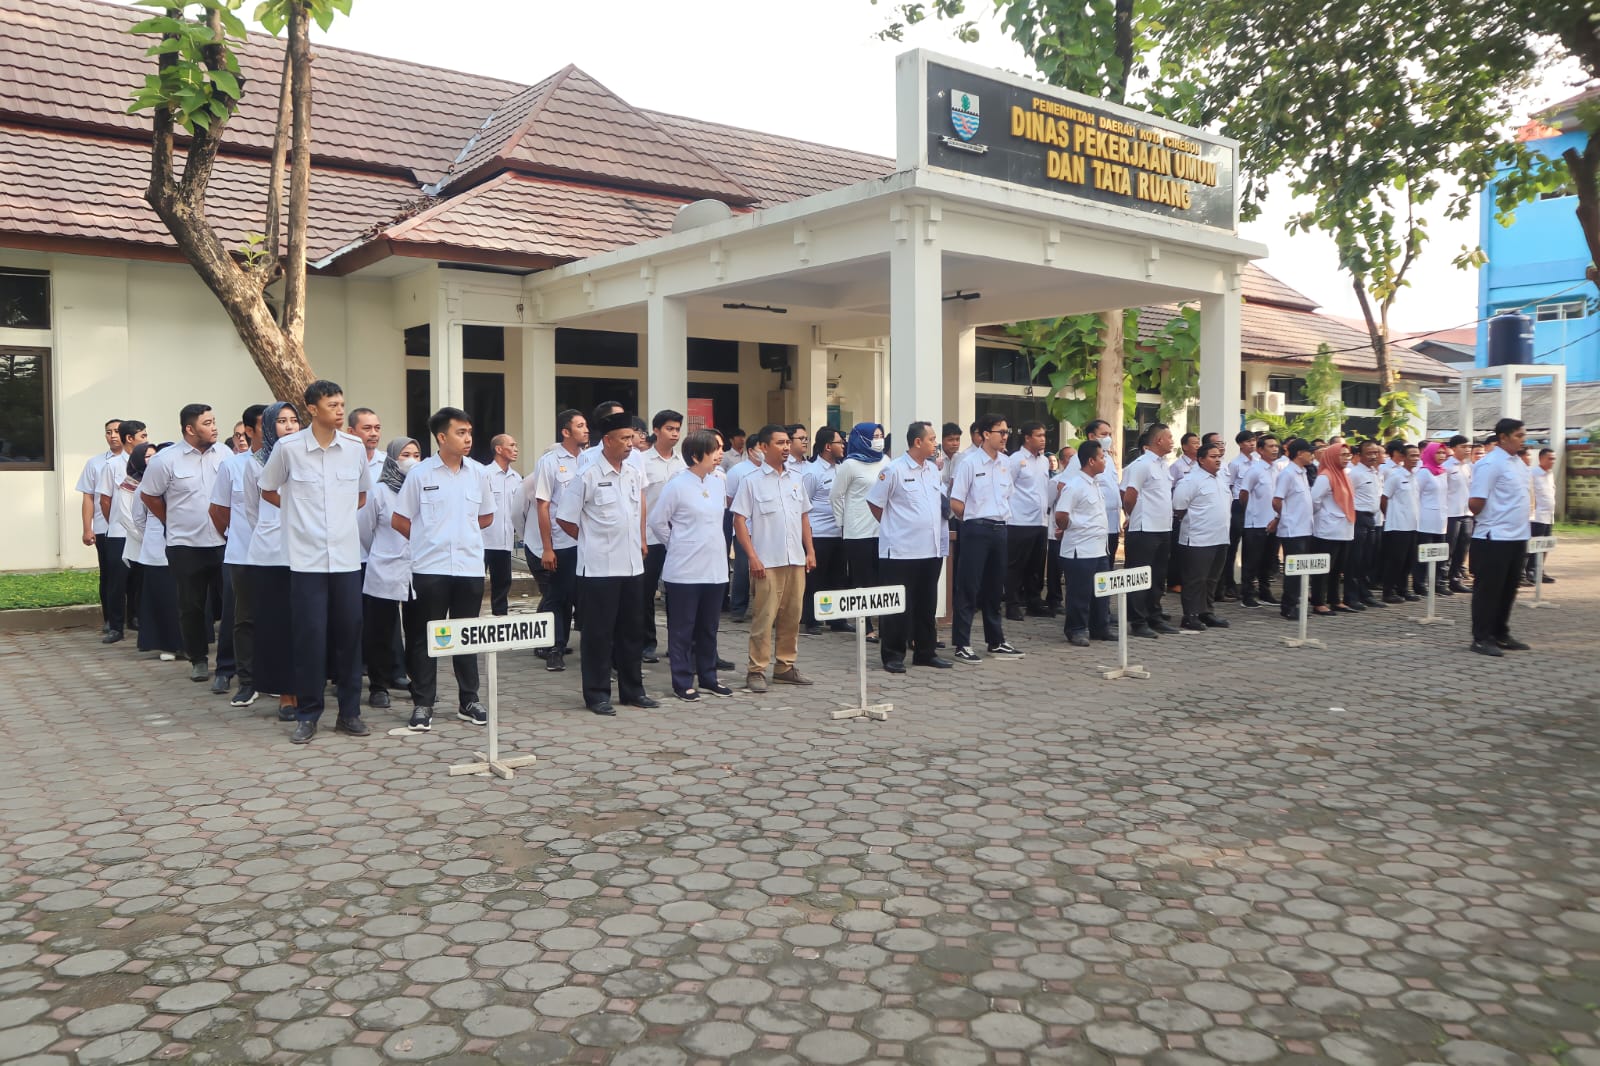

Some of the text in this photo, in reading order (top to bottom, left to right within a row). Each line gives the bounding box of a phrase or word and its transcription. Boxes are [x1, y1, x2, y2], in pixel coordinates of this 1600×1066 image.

[1011, 106, 1217, 187] DINAS PEKERJAAN UMUM
[1032, 97, 1201, 155] PEMERINTAH DAERAH KOTA CIREBON
[1047, 150, 1192, 210] DAN TATA RUANG
[1110, 571, 1148, 590] TATA RUANG
[840, 592, 900, 612] CIPTA KARYA
[461, 621, 548, 645] SEKRETARIAT
